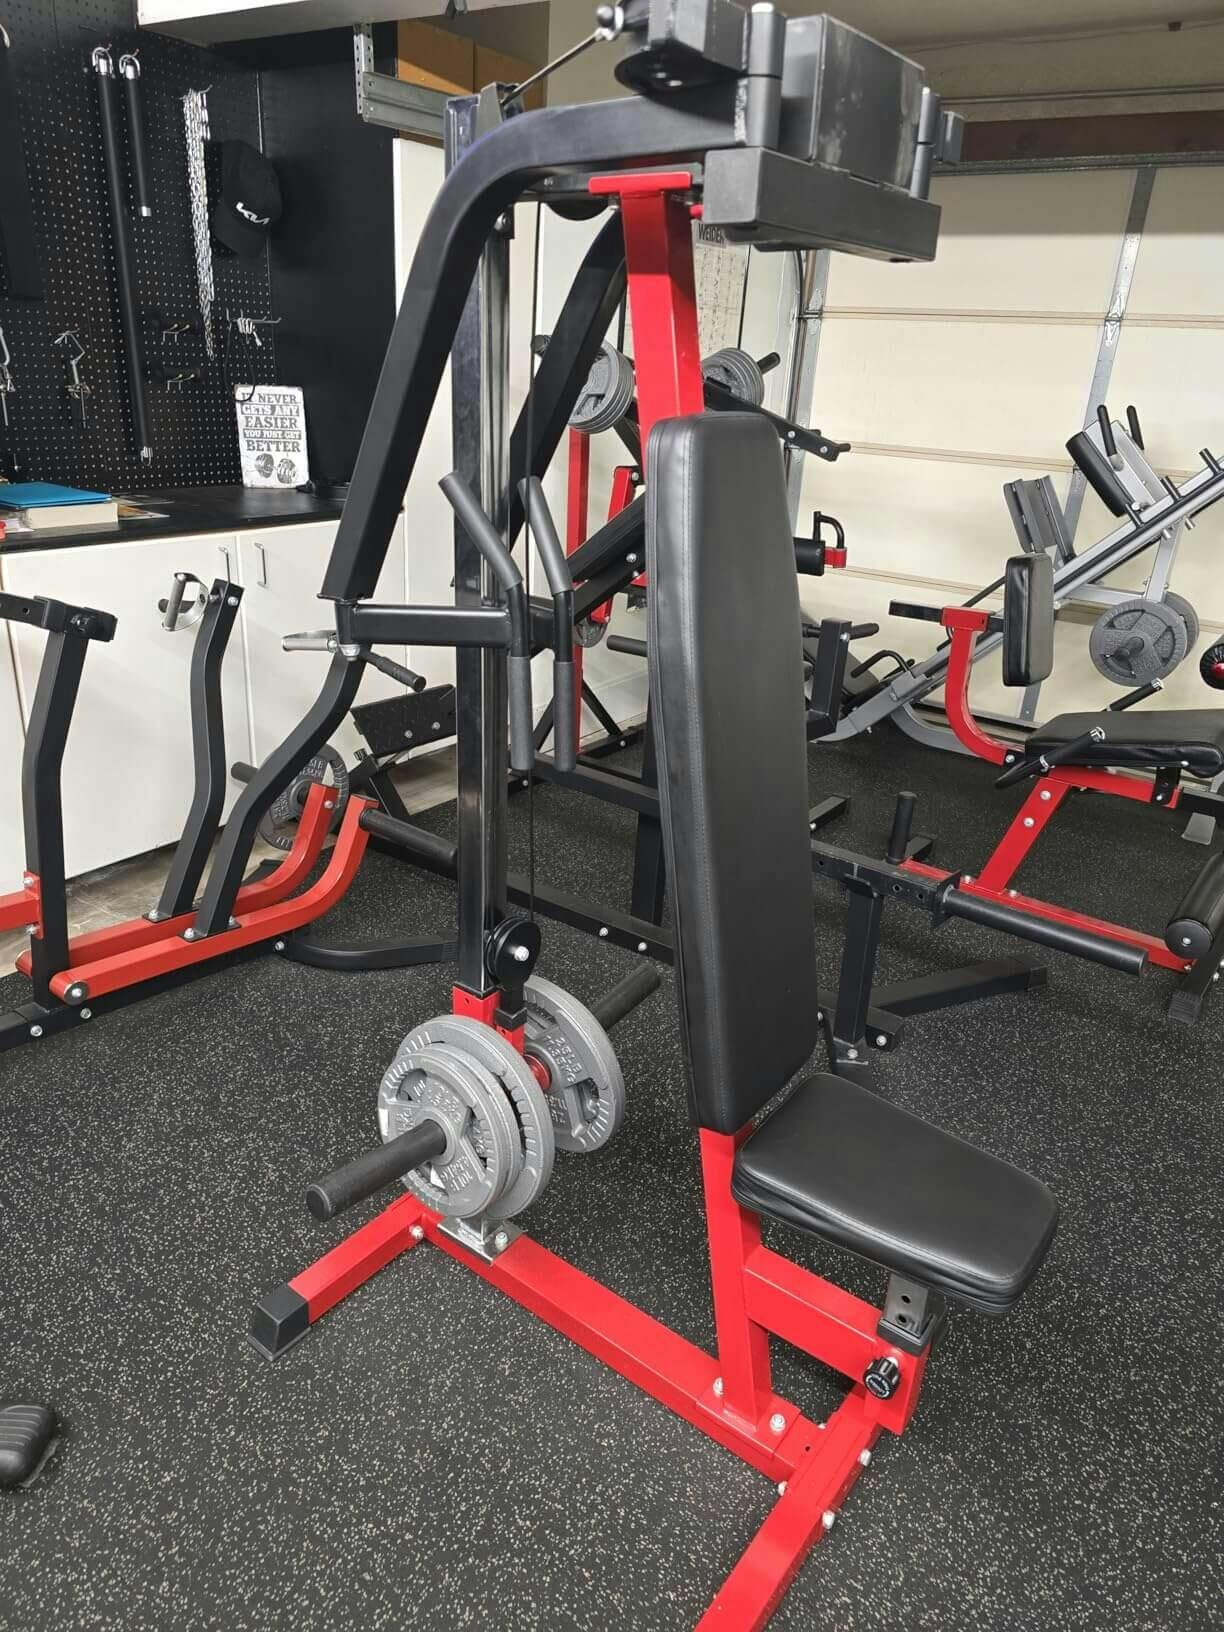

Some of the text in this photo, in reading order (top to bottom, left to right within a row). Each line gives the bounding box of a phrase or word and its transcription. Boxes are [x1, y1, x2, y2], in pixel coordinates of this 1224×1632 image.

[258, 393, 297, 404] NEVER
[242, 404, 299, 416] GETS ANY
[244, 416, 298, 429] EASIER
[244, 430, 261, 438] YOU
[246, 440, 301, 452] BETTER
